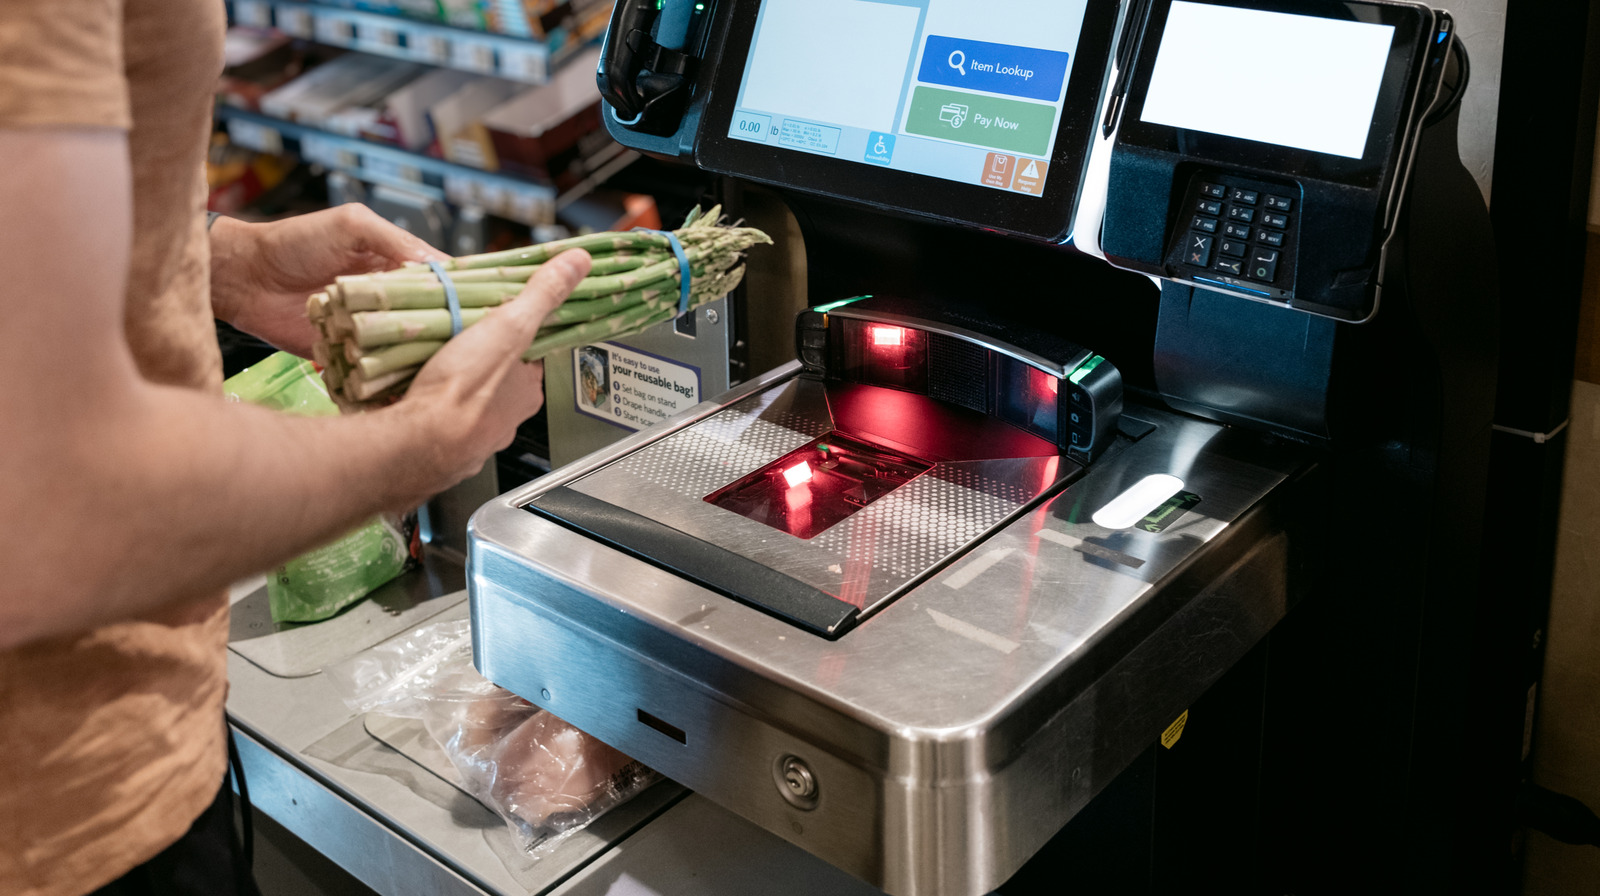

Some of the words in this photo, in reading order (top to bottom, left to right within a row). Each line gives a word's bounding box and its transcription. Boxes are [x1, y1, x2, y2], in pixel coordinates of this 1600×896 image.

[971, 59, 993, 72] Item
[996, 63, 1034, 80] Lookup
[740, 120, 760, 133] 0.00
[770, 125, 779, 135] lb
[974, 113, 992, 128] Pay
[994, 117, 1019, 130] Now
[866, 153, 890, 163] Accessibility
[612, 352, 622, 362] It's
[623, 357, 638, 369] easy
[640, 361, 647, 369] to
[648, 366, 660, 374] use
[612, 364, 632, 376] your
[634, 371, 672, 390] reusable
[674, 381, 694, 398] bag!
[622, 383, 632, 394] Set
[634, 387, 646, 400] bag
[647, 394, 656, 402] on
[658, 397, 676, 409] stand
[622, 397, 642, 411] Drape
[623, 410, 639, 422] Start
